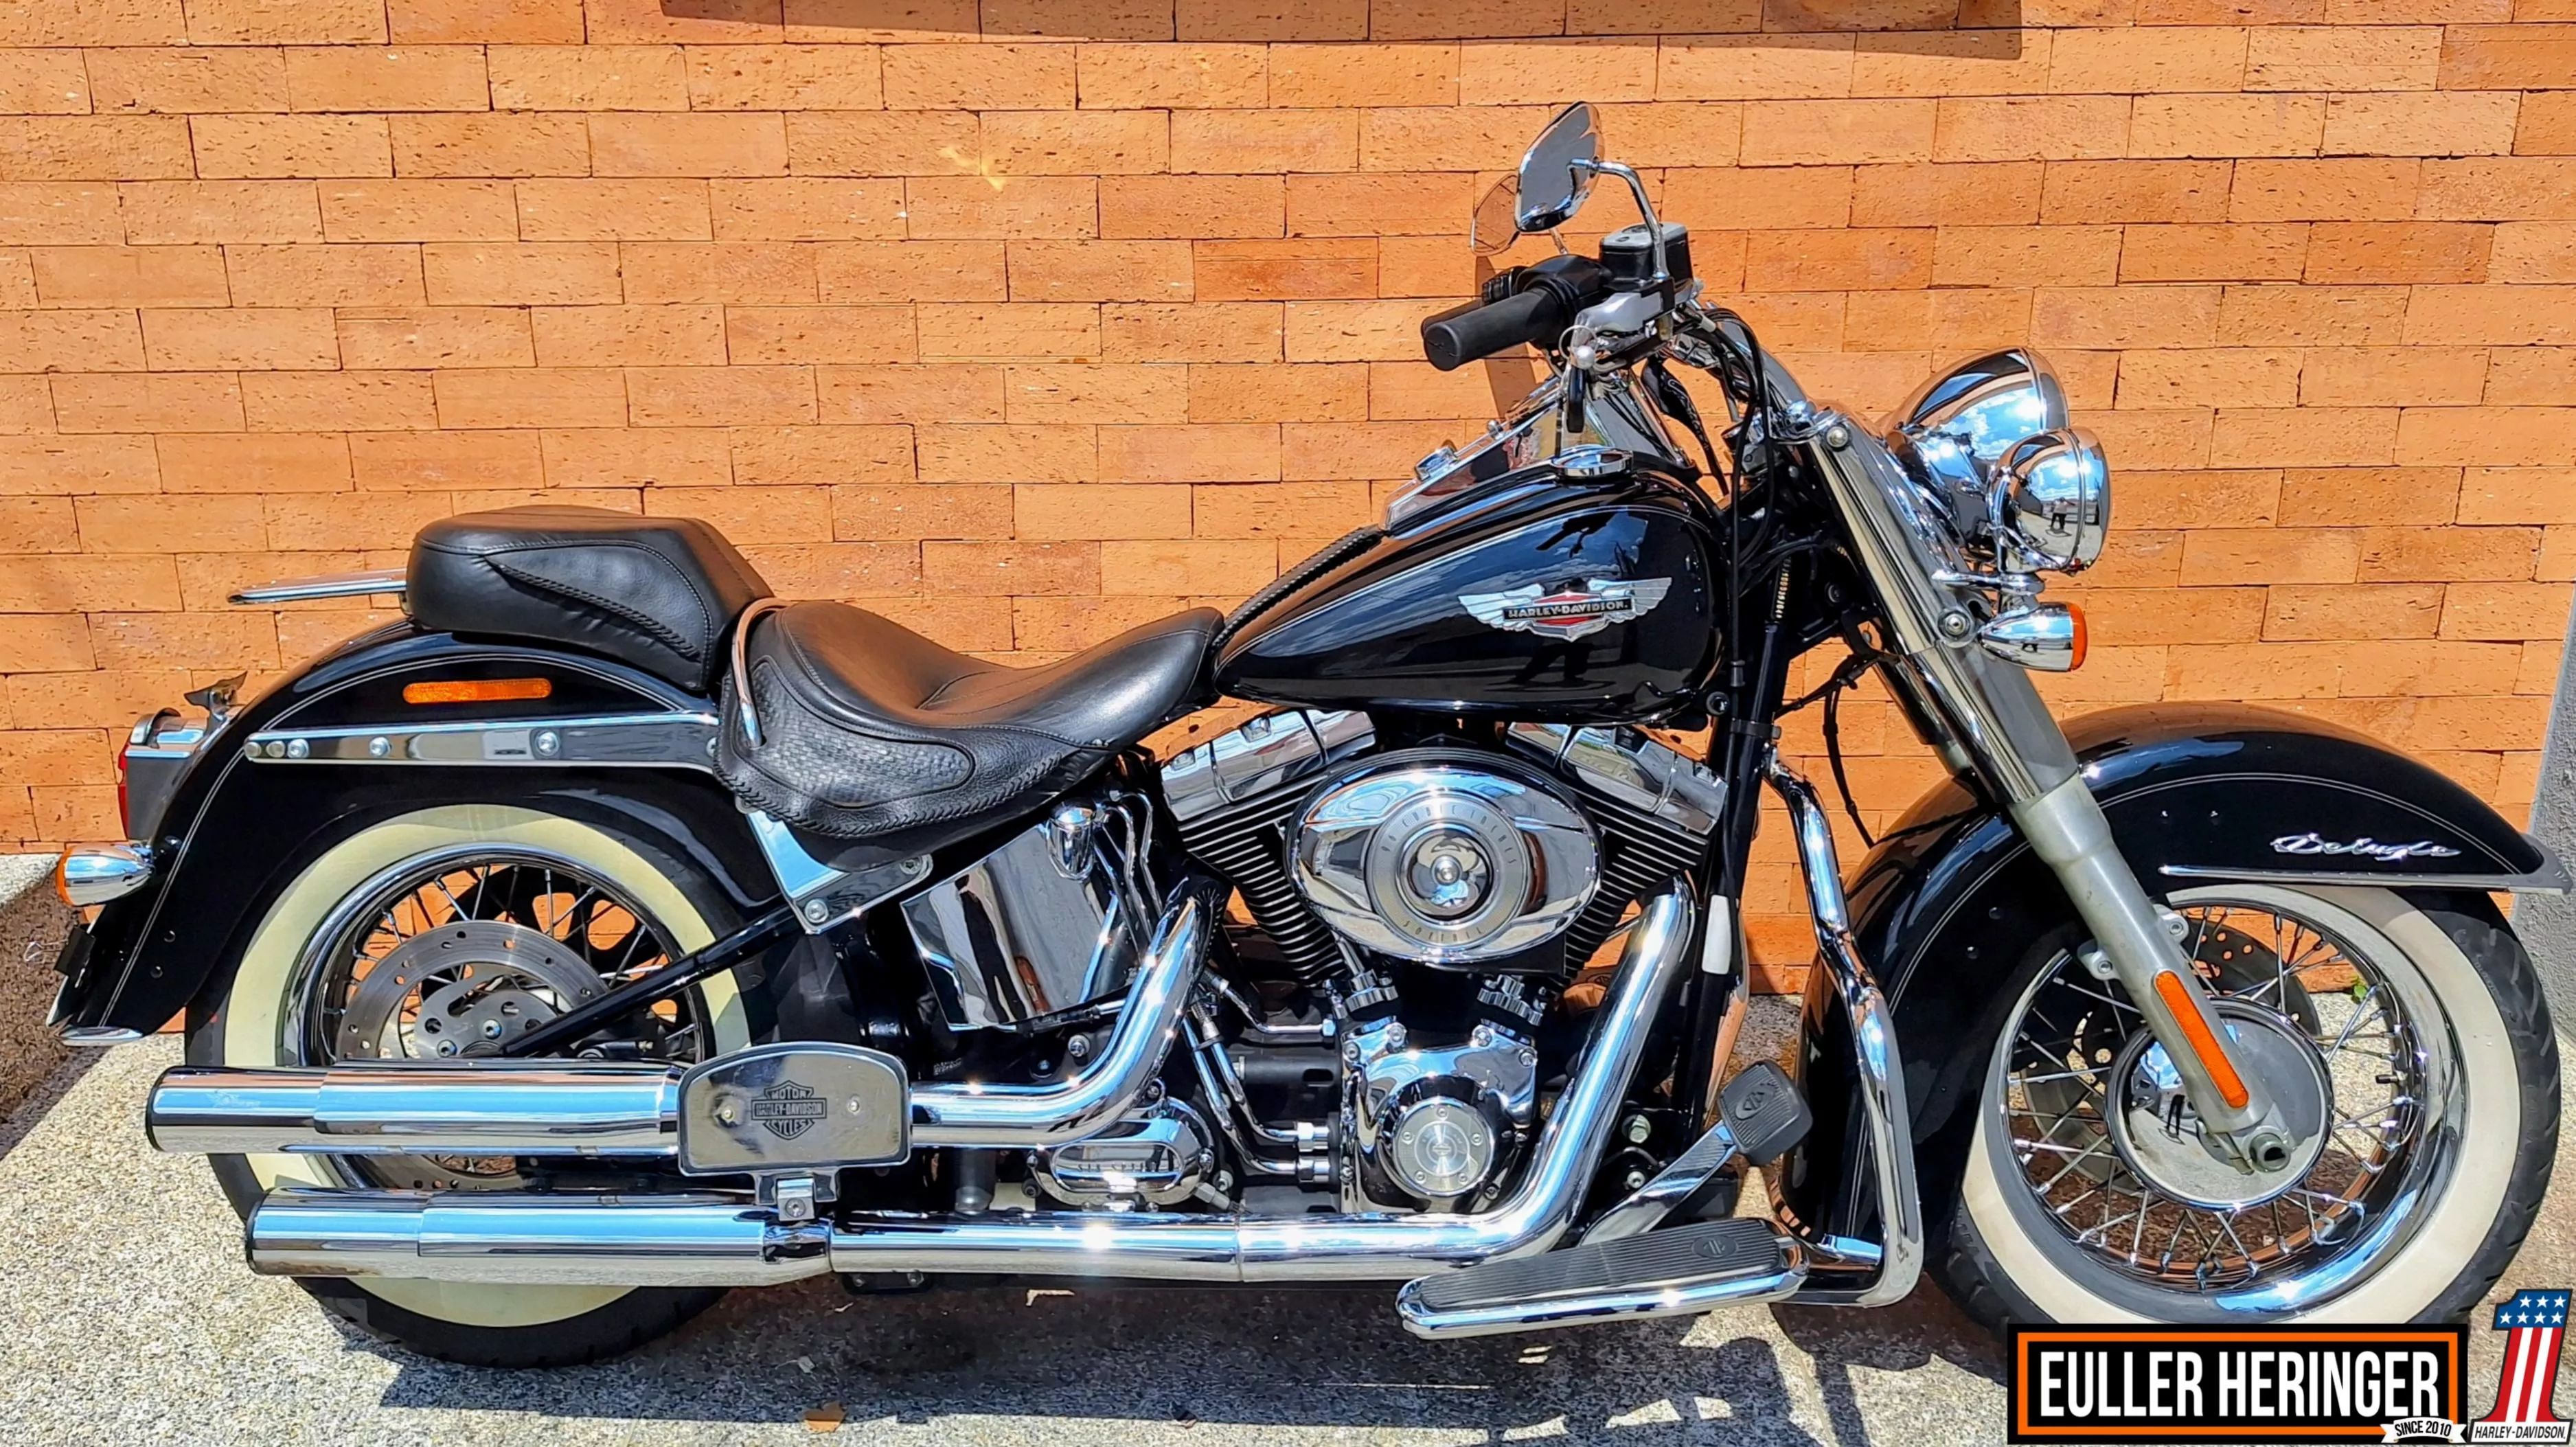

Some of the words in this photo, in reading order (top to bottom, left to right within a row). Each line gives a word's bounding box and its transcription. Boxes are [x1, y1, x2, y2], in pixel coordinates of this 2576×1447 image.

[2270, 832, 2462, 861] Deluxe
[1403, 920, 1482, 942] SOFTAIL
[771, 1089, 807, 1099] MOTOR
[755, 1103, 823, 1116] HARLEY-DAVIDSON
[771, 1119, 807, 1135] CYCLES
